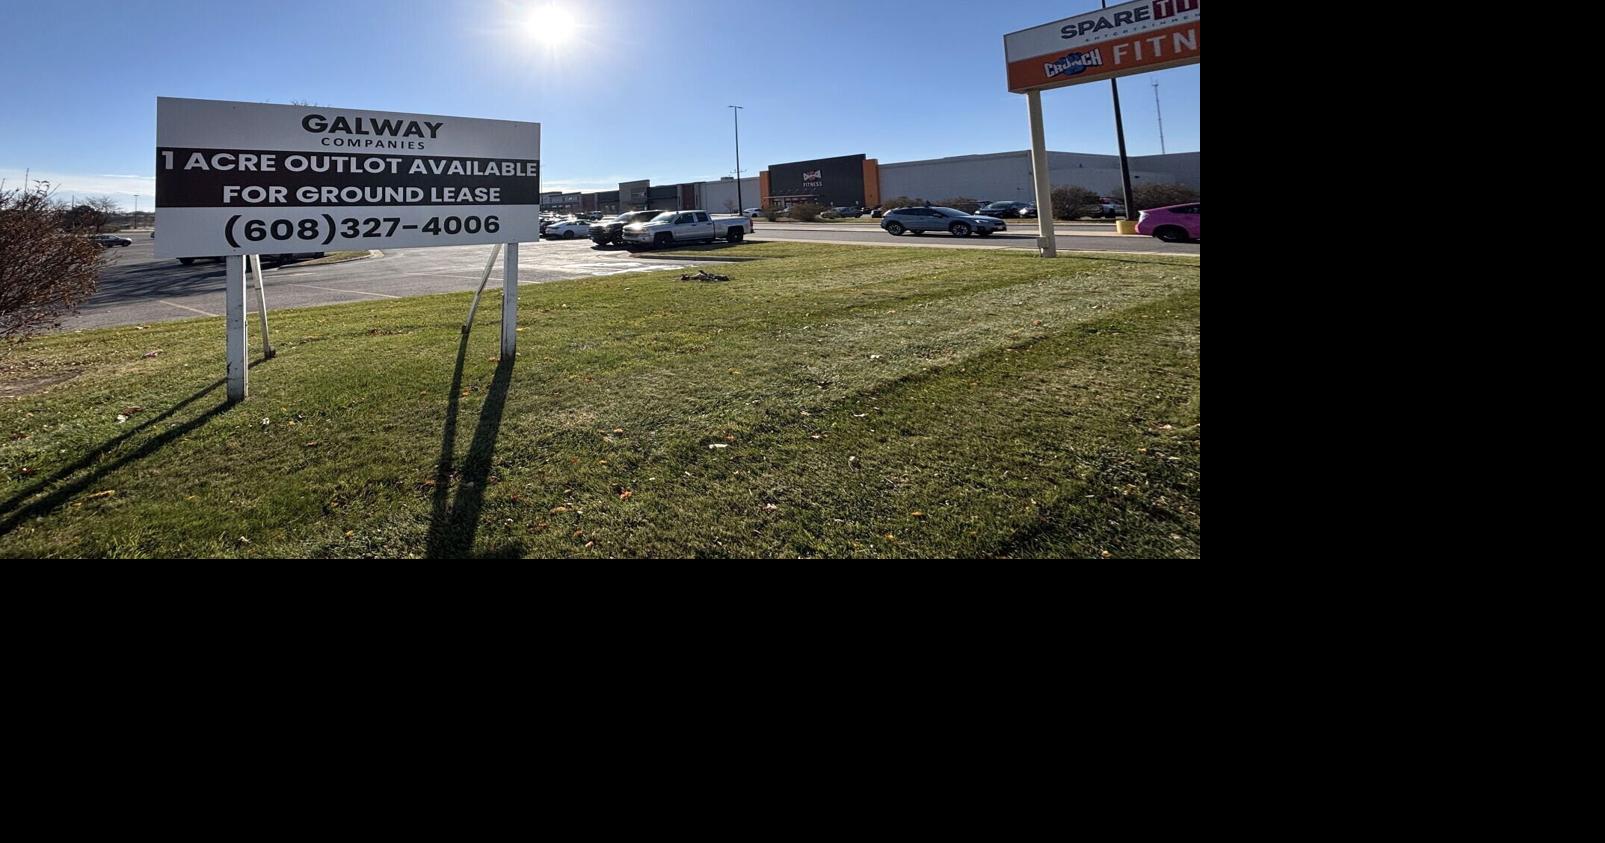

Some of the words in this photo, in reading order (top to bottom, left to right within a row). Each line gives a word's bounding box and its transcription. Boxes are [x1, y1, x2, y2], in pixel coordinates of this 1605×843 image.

[1061, 5, 1150, 39] SPARE
[1044, 48, 1102, 77] CRUNCH
[1113, 29, 1197, 65] FITN
[301, 114, 443, 139] GALWAY
[321, 138, 425, 150] COMPANIES
[162, 151, 174, 170] 1
[184, 153, 276, 172] ACRE
[284, 155, 402, 175] OUTLOT
[409, 159, 537, 178] AVAILABLE
[223, 186, 287, 204] FOR
[296, 187, 424, 204] GROUND
[431, 187, 501, 203] LEASE
[225, 213, 500, 247] (608)327-4006
